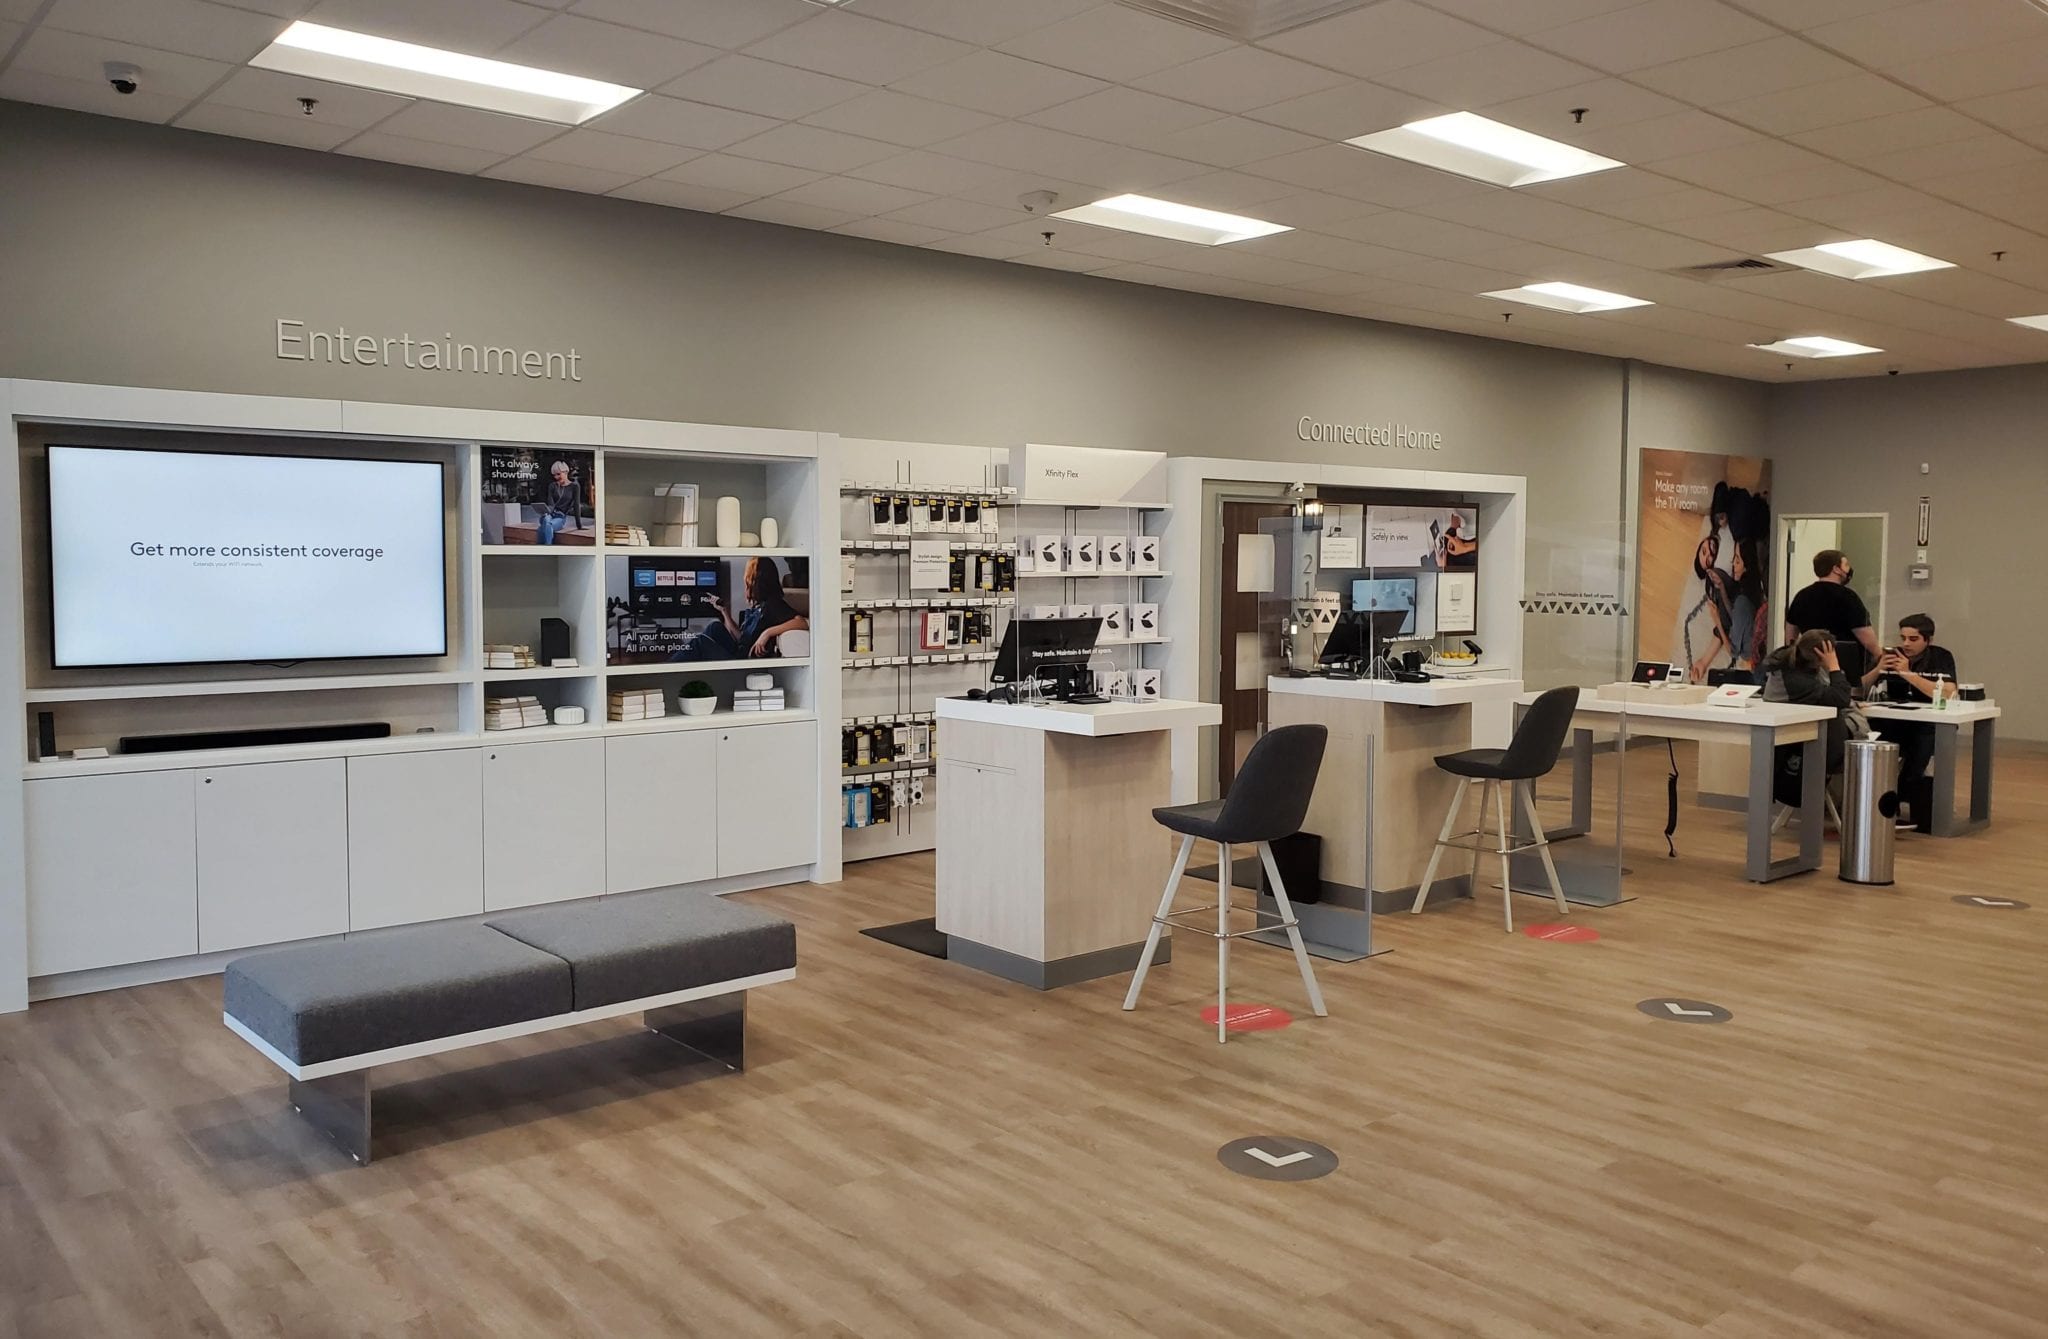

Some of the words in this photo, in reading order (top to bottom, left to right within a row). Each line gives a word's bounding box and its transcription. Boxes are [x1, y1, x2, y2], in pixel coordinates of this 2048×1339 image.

[275, 318, 583, 382] Entertainment
[1297, 415, 1391, 447] Connected
[1394, 423, 1442, 451] Home
[491, 458, 506, 468] It's
[506, 458, 540, 472] always
[491, 469, 538, 480] showtime
[1045, 468, 1066, 480] Xfinity
[1066, 469, 1080, 478] Flex
[1655, 478, 1675, 493] Make
[1675, 484, 1689, 497] any
[1690, 484, 1709, 495] room
[1655, 495, 1668, 509] the
[1668, 495, 1679, 510] TV
[1679, 500, 1698, 511] room
[1371, 532, 1389, 543] Safely
[130, 541, 165, 557] Get
[169, 544, 216, 558] more
[220, 543, 308, 558] consistent
[311, 545, 384, 562] coverage
[625, 631, 637, 641] All
[639, 634, 658, 643] your
[625, 643, 637, 653] All
[639, 644, 648, 652] in
[649, 644, 666, 652] one
[667, 642, 694, 654] place.
[1032, 650, 1044, 659] Stay
[1056, 648, 1077, 656] Maintain
